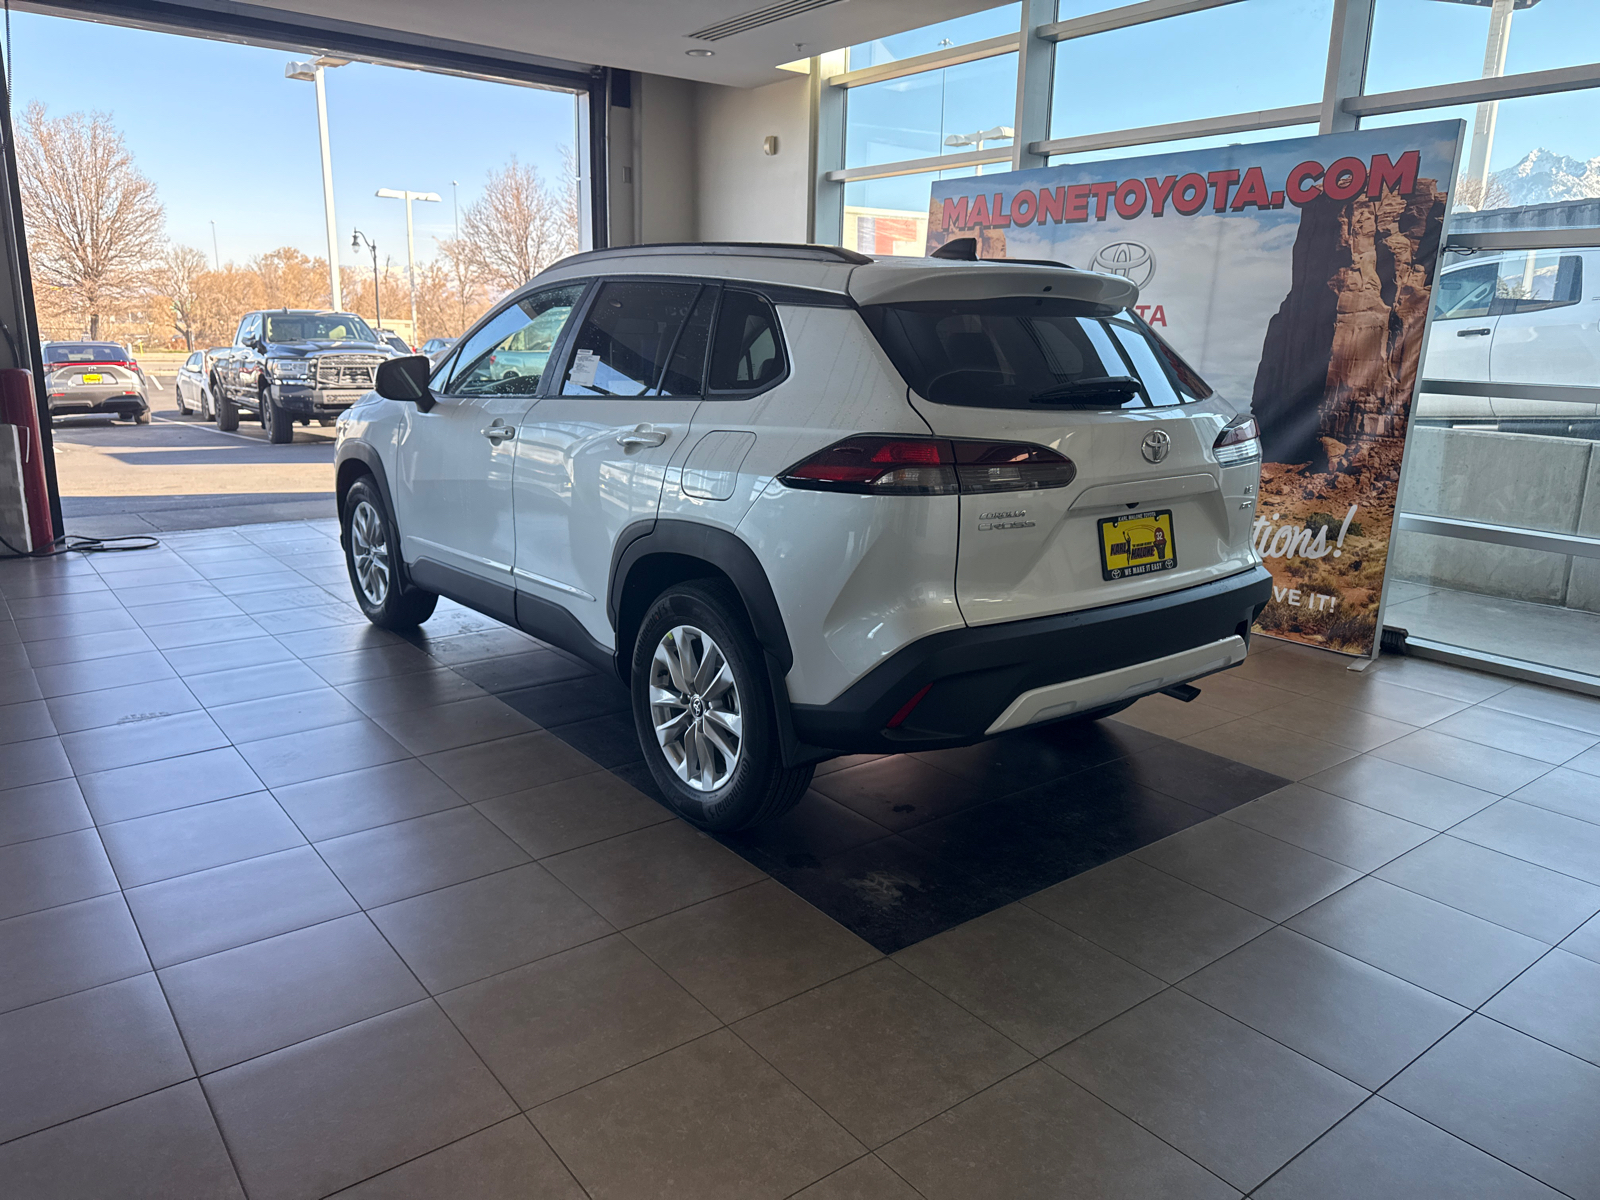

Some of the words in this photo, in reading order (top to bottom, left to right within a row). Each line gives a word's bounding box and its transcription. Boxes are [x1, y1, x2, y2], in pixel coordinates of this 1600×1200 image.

[942, 150, 1421, 231] MALONETOYOTA.COM
[1253, 504, 1358, 560] tions!
[1124, 568, 1132, 576] WE
[1132, 565, 1146, 574] MAKE
[1151, 562, 1162, 571] EASY
[1273, 585, 1302, 606] VE
[1308, 592, 1337, 613] IT!
